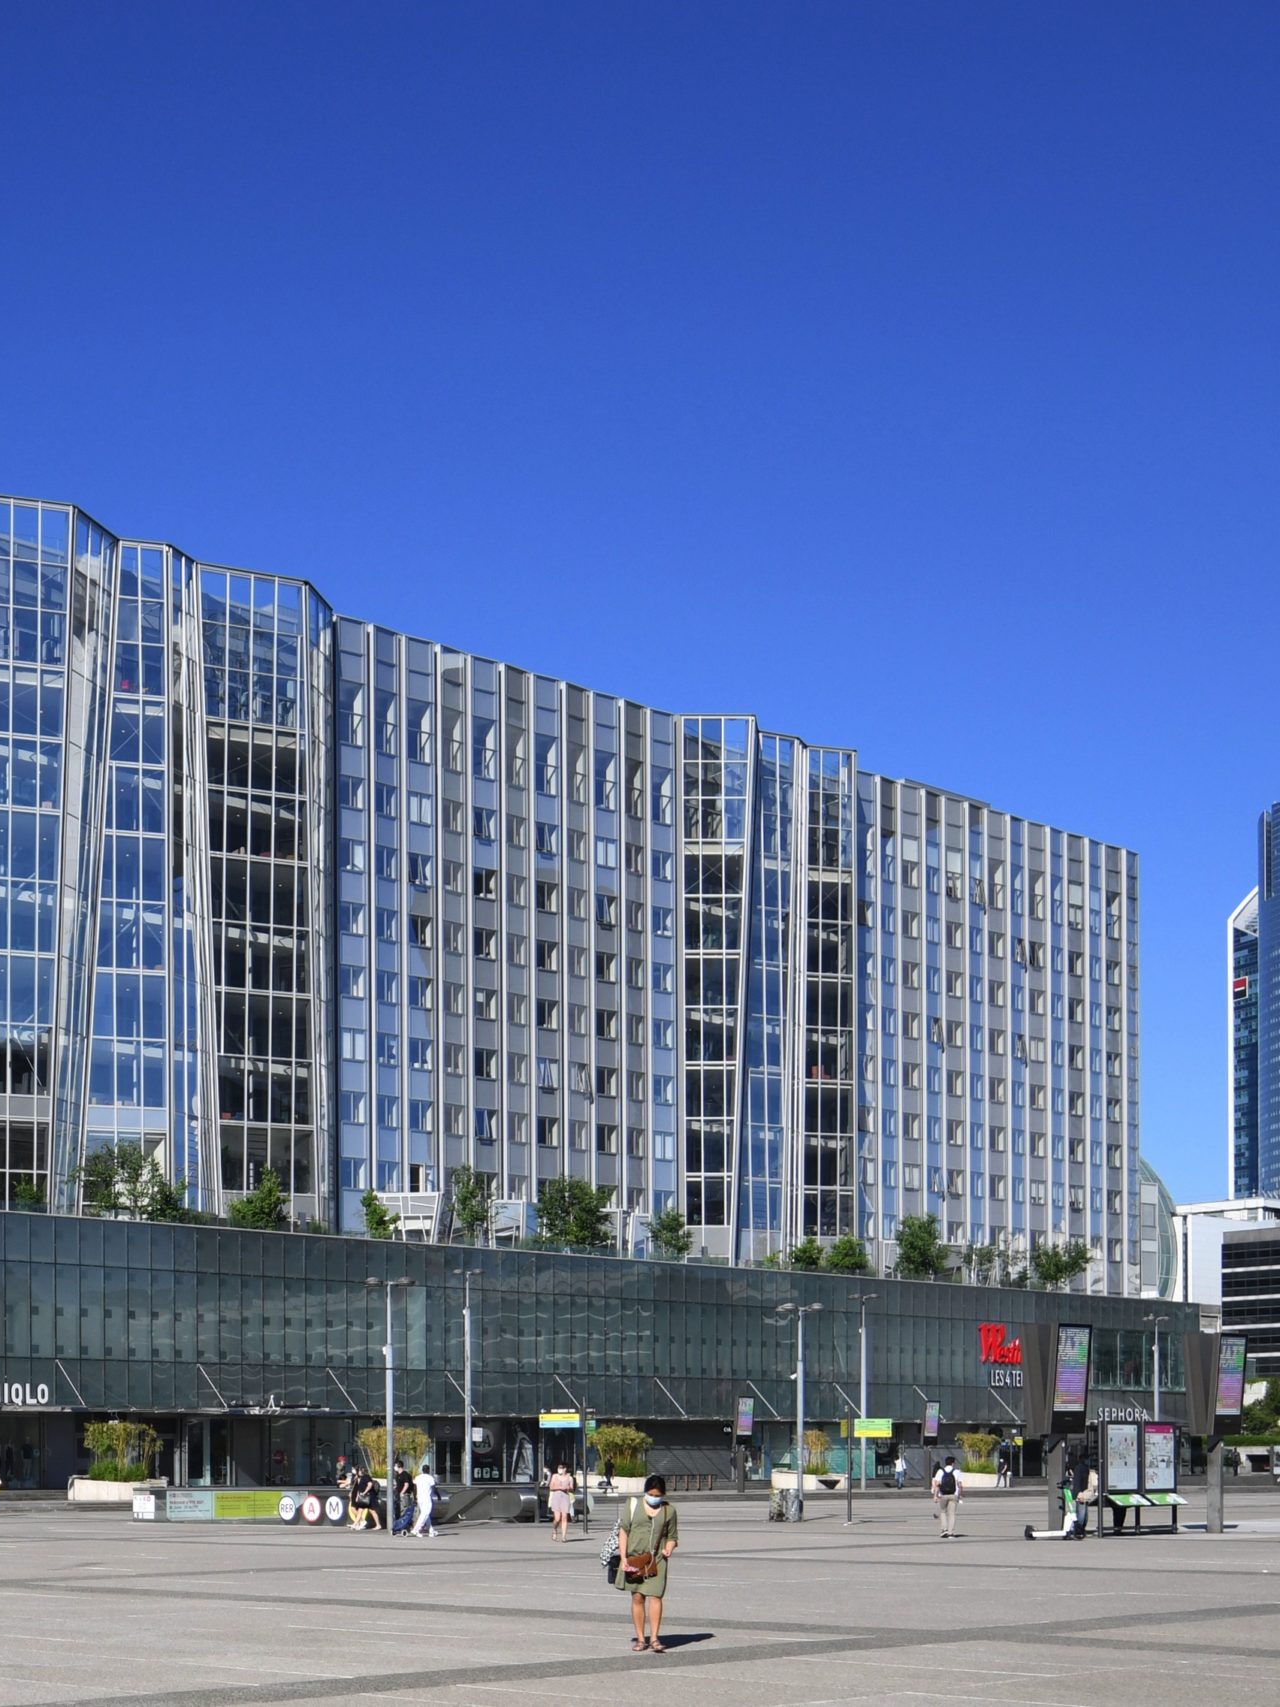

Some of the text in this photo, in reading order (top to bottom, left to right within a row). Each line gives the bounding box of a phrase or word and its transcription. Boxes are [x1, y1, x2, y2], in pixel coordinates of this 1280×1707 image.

[991, 1369, 1004, 1386] LES
[1006, 1370, 1012, 1386] 4
[1098, 1407, 1149, 1421] SEPHORA
[280, 1503, 294, 1514] RER
[307, 1502, 316, 1514] A
[329, 1502, 340, 1515] M
